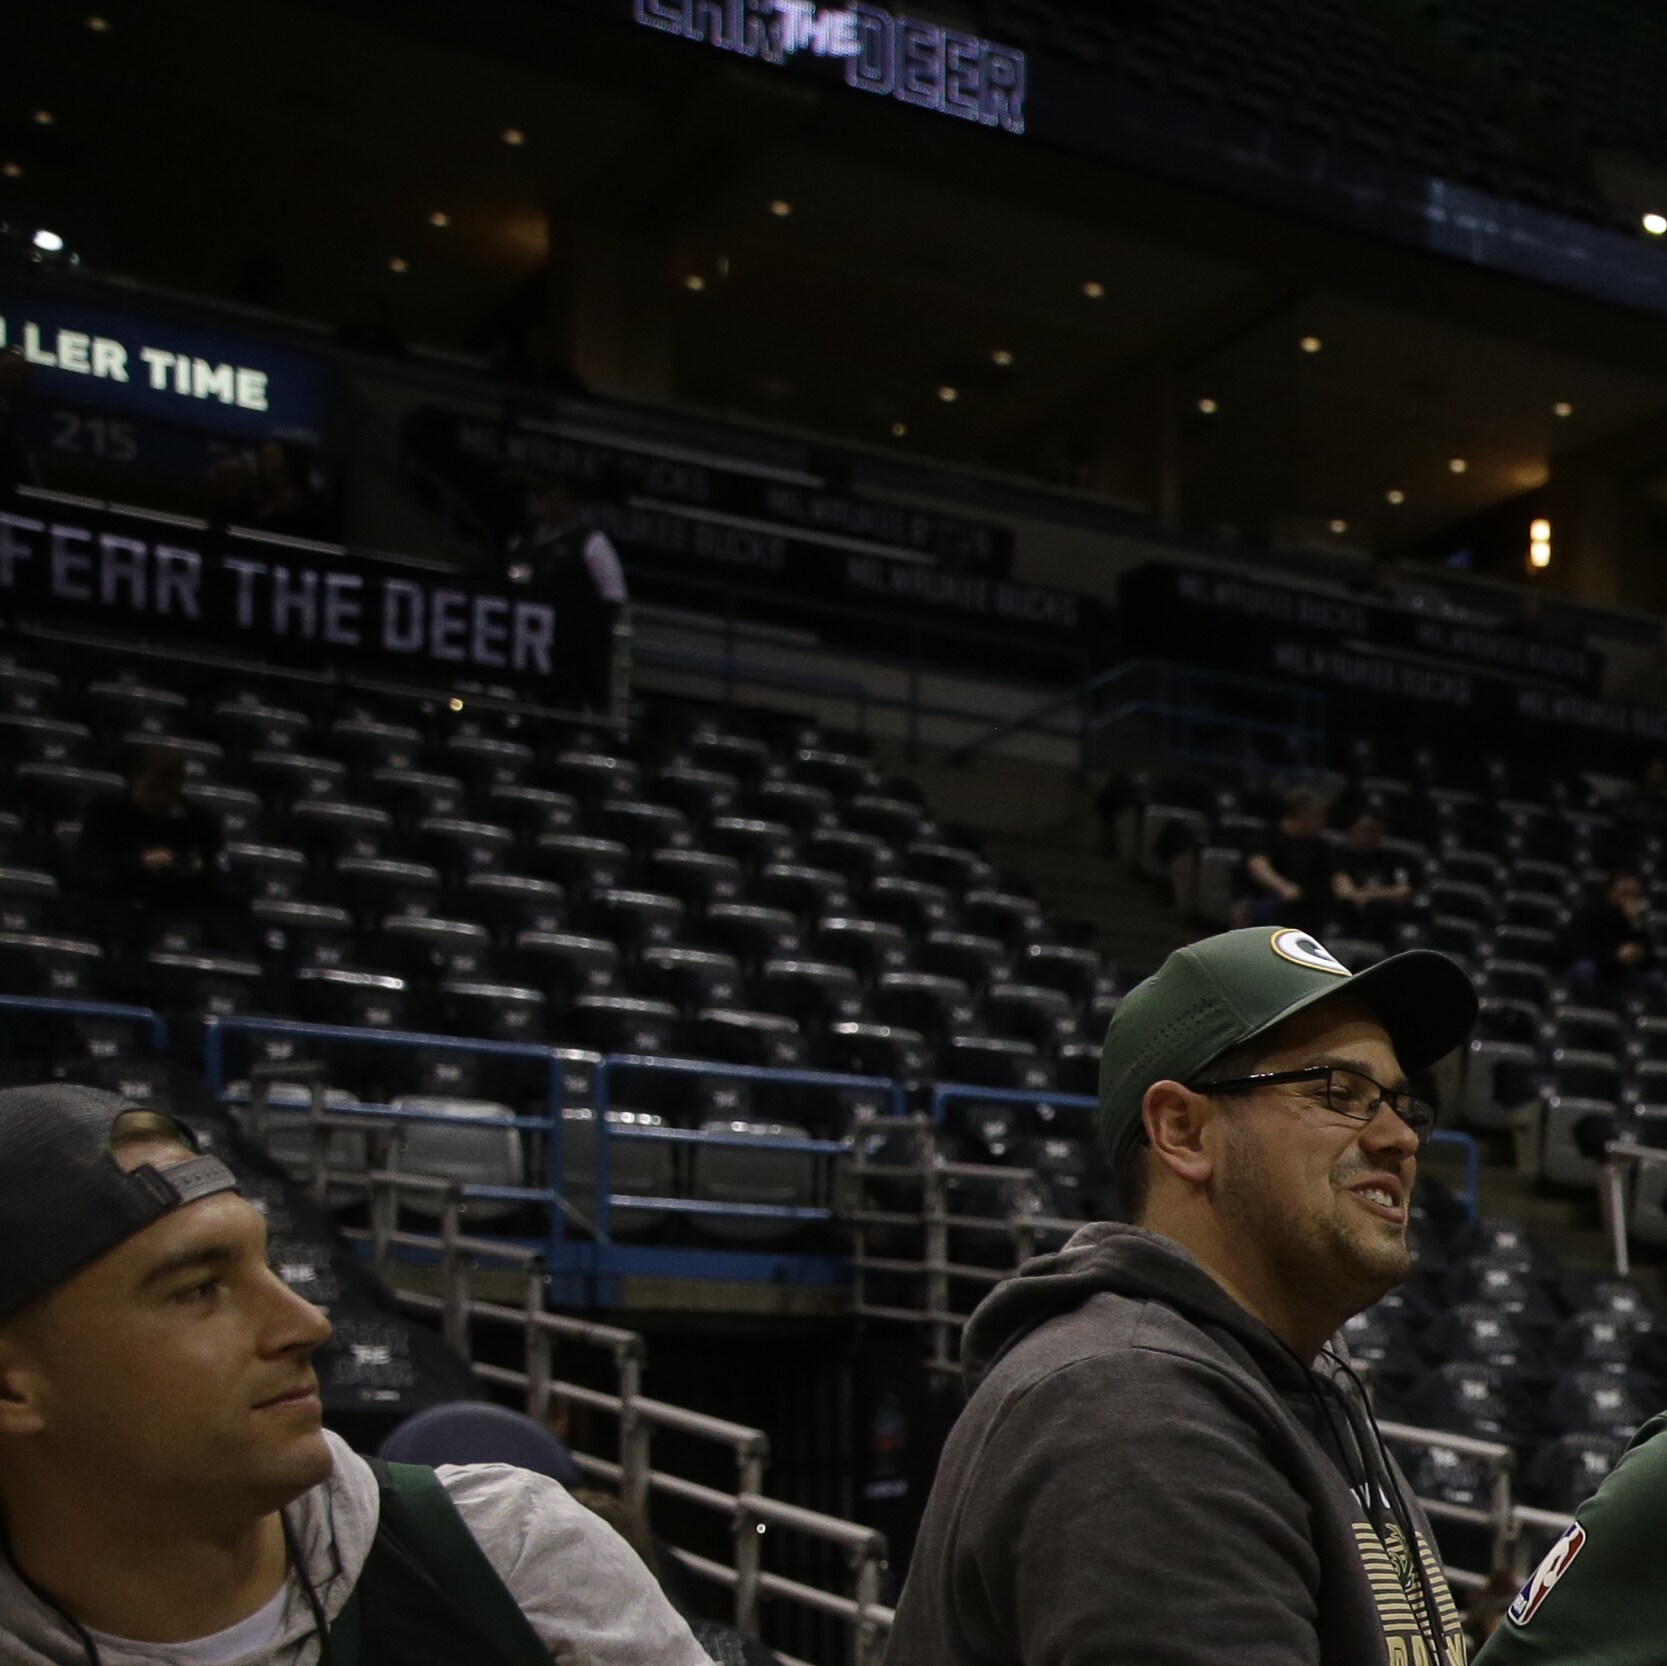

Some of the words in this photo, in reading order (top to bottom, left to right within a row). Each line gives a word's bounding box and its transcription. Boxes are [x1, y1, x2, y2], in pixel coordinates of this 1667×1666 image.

[846, 0, 1025, 135] DEER
[139, 345, 270, 413] TIME
[51, 409, 139, 464] 215
[0, 511, 202, 621] FEAR
[221, 556, 365, 648] THE
[379, 576, 557, 677] DEER
